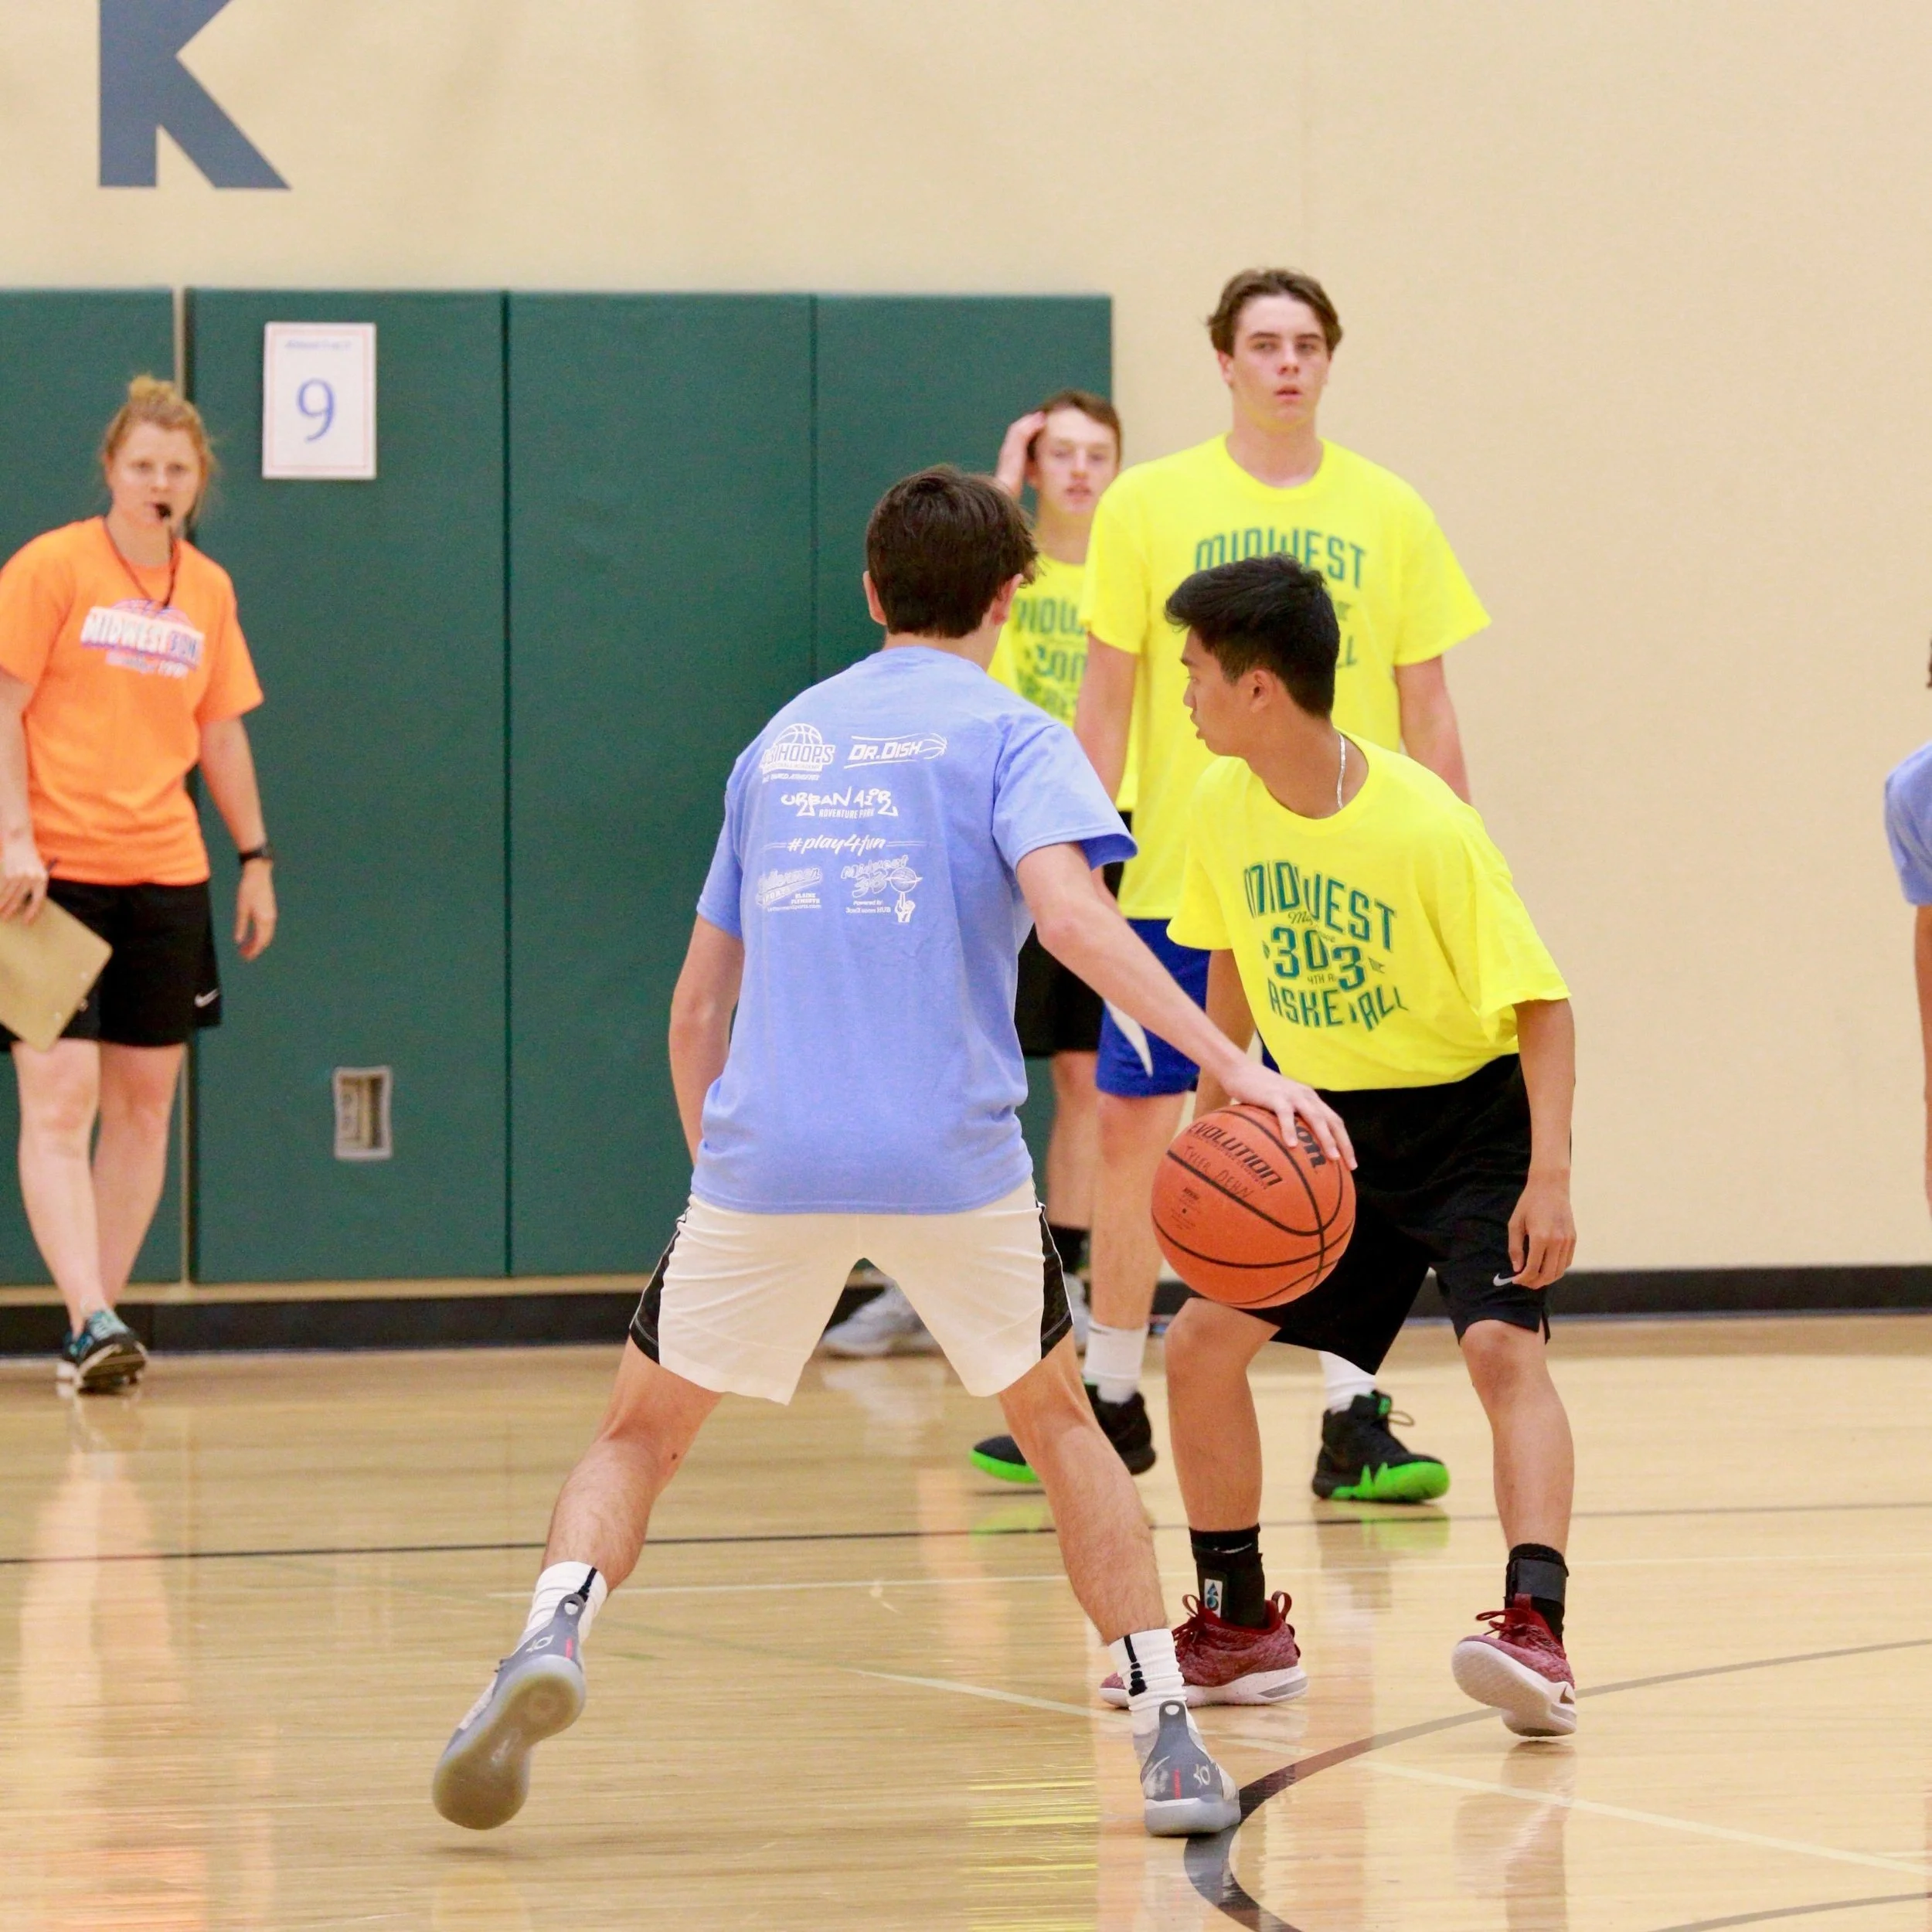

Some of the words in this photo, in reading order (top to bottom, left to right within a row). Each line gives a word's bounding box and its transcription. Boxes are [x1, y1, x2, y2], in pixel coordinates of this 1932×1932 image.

[98, 0, 292, 190] K
[296, 377, 337, 442] 9
[1194, 528, 1366, 590] MIDWEST
[787, 833, 886, 856] #play4fun
[818, 808, 858, 819] ADVENTURE
